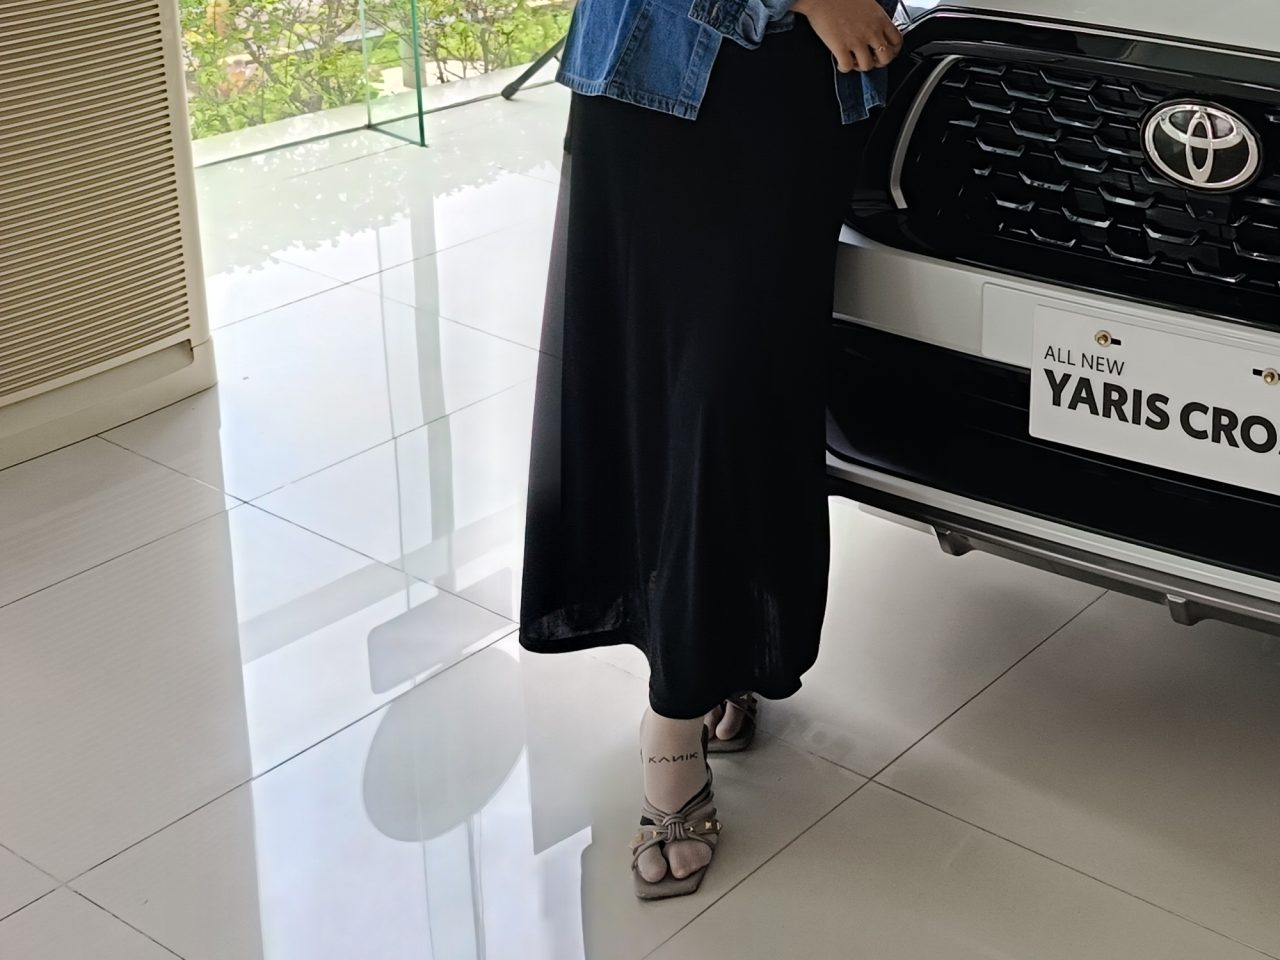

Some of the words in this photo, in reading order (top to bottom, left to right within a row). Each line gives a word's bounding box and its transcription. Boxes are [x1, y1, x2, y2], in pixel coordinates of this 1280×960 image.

[1044, 345, 1076, 366] ALL
[1081, 352, 1125, 376] NEW
[1044, 368, 1171, 431] YARIS
